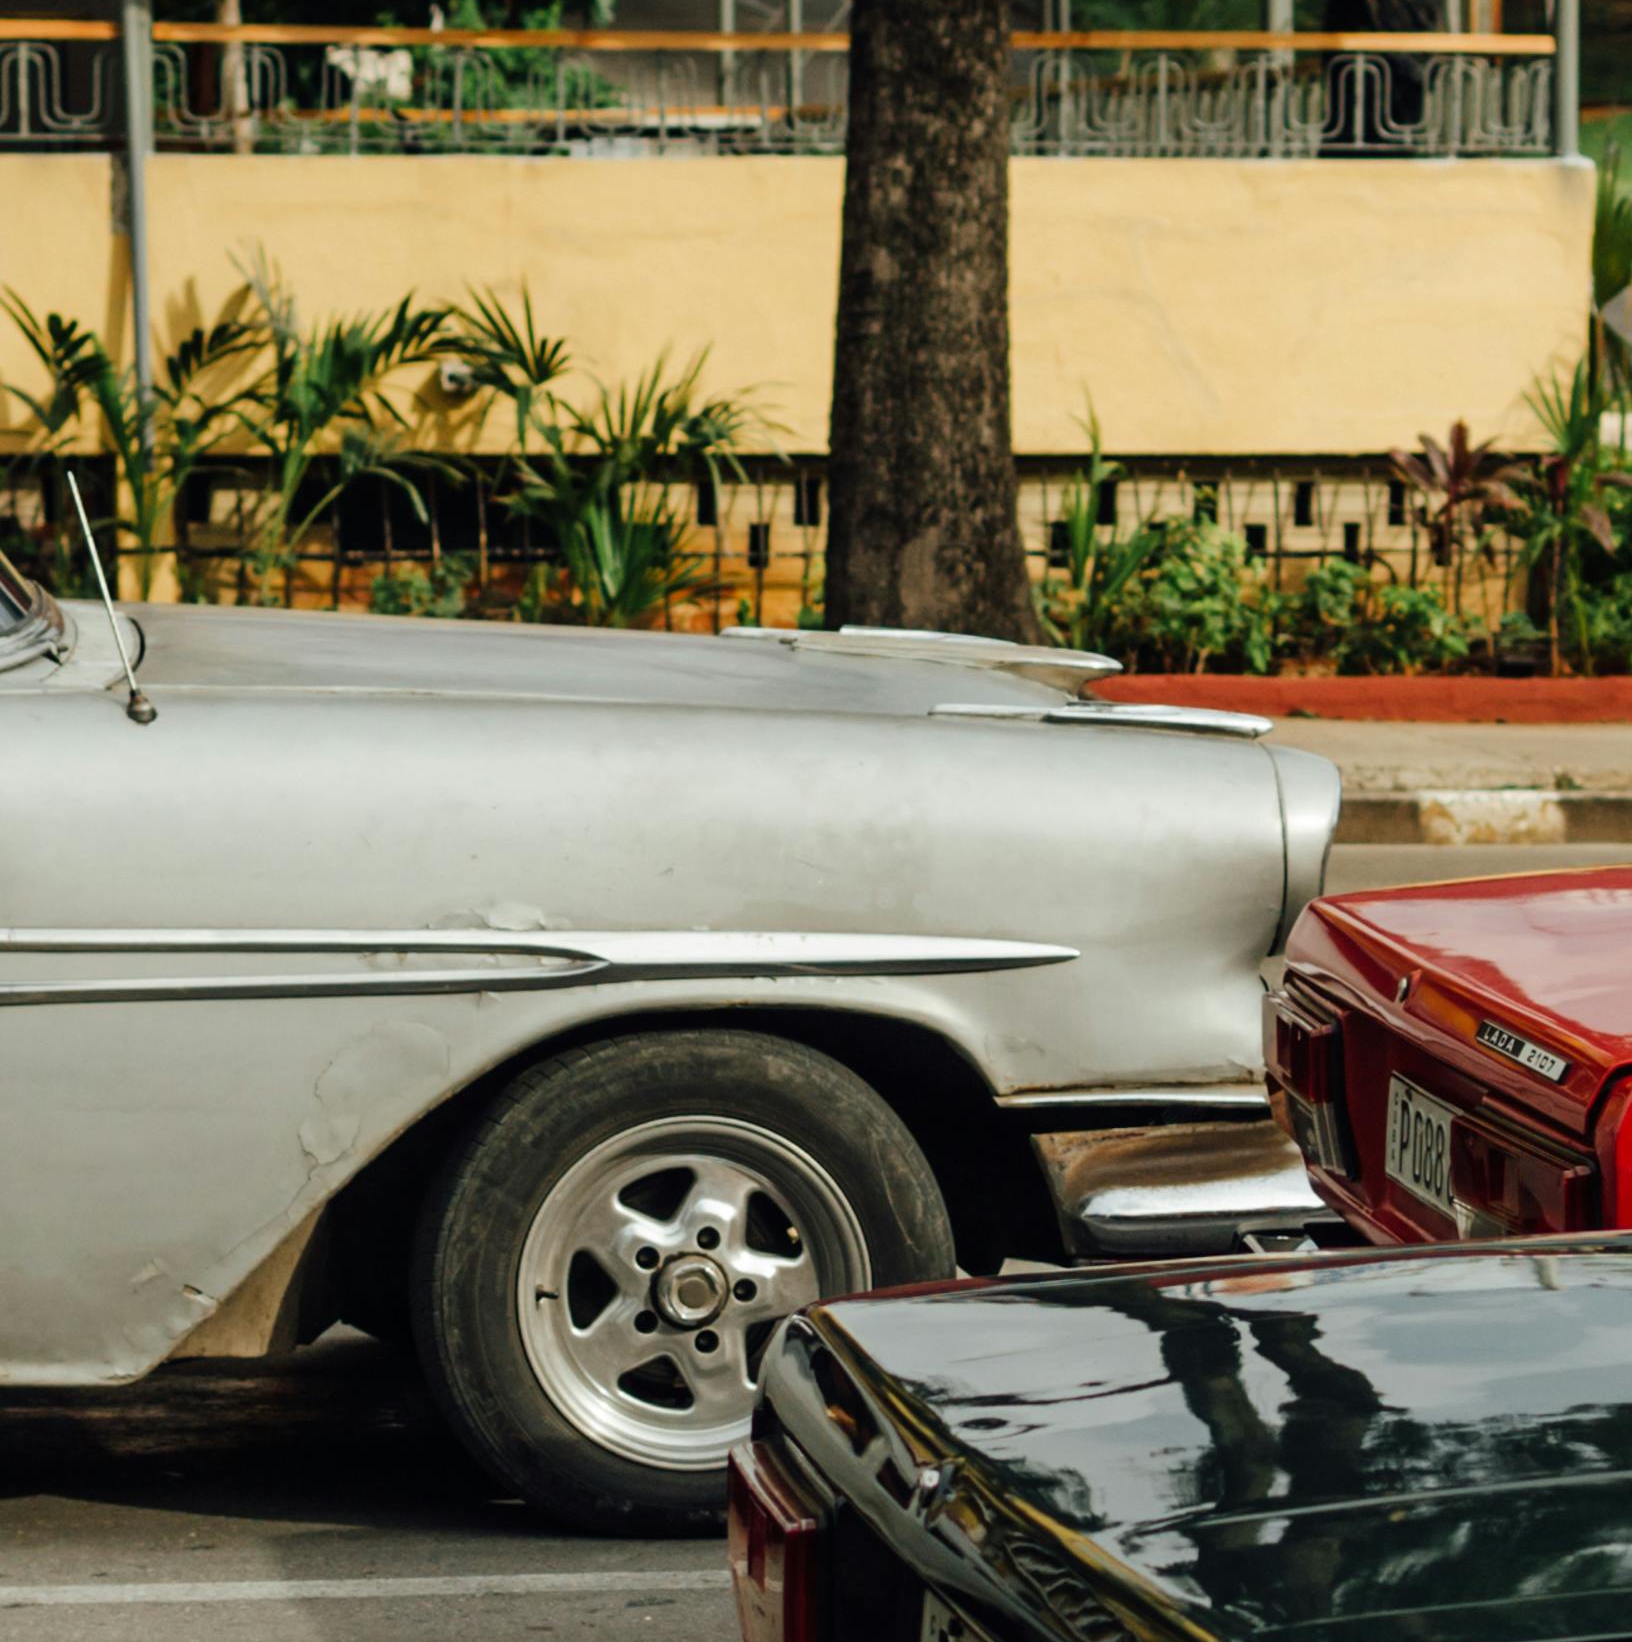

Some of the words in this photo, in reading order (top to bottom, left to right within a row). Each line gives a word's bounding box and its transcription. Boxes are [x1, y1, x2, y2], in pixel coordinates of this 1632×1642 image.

[1483, 1026, 1515, 1052] LADA
[1526, 1049, 1557, 1073] 2107
[1398, 1098, 1455, 1205] P088
